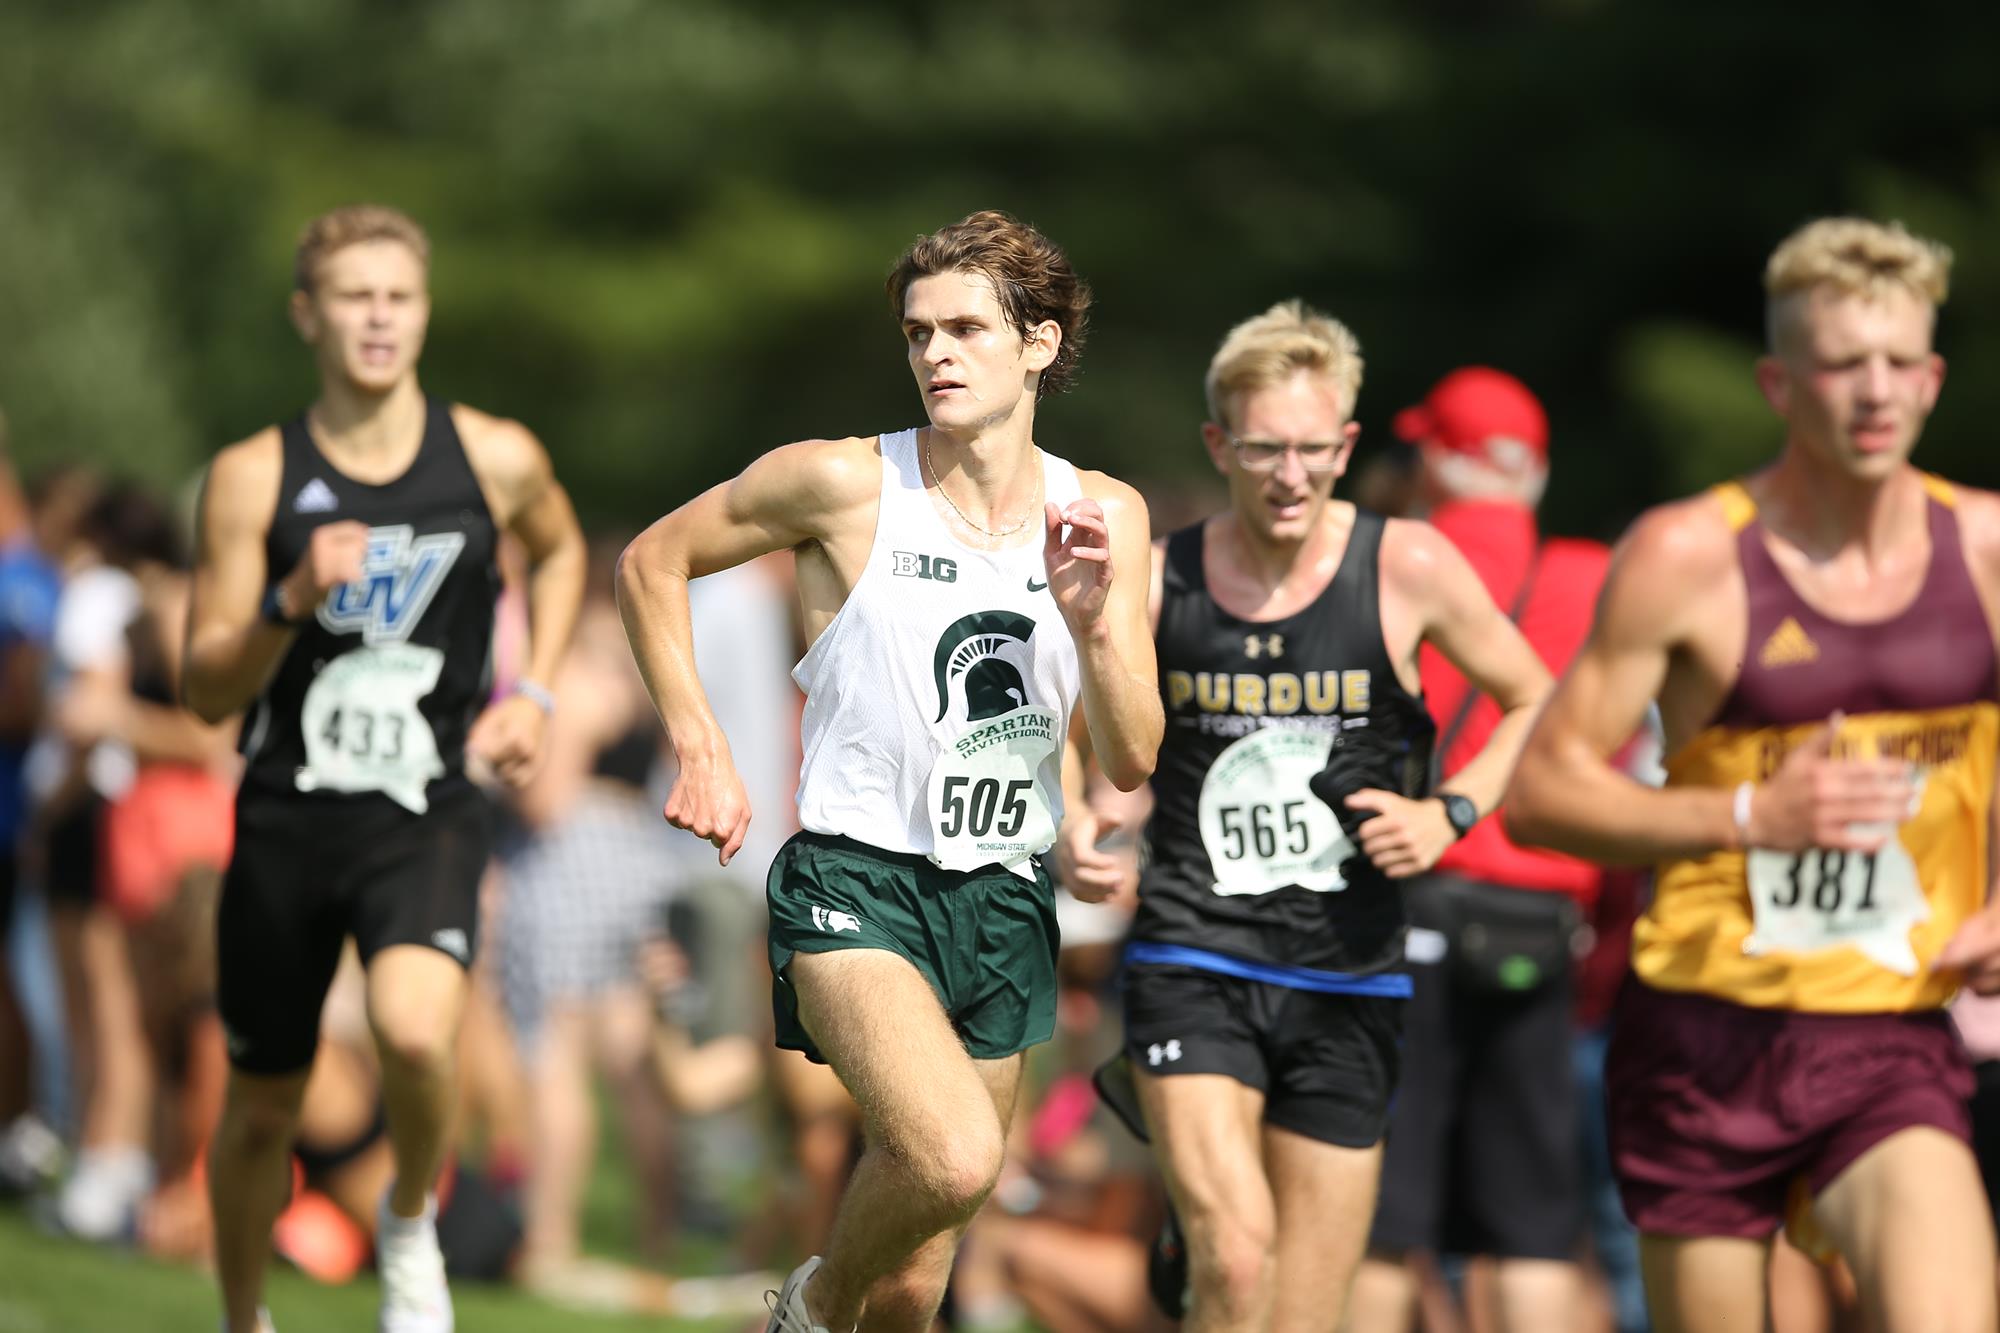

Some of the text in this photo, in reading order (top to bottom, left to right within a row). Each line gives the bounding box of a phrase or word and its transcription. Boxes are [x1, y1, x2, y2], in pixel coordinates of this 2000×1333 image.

[1167, 669, 1371, 716] PURDUE
[320, 704, 406, 760] 433
[956, 714, 1054, 752] SPARTAN
[962, 728, 1052, 760] INVITATIONAL
[940, 776, 1034, 838] 505
[1219, 800, 1310, 861] 565
[1771, 847, 1882, 913] 381
